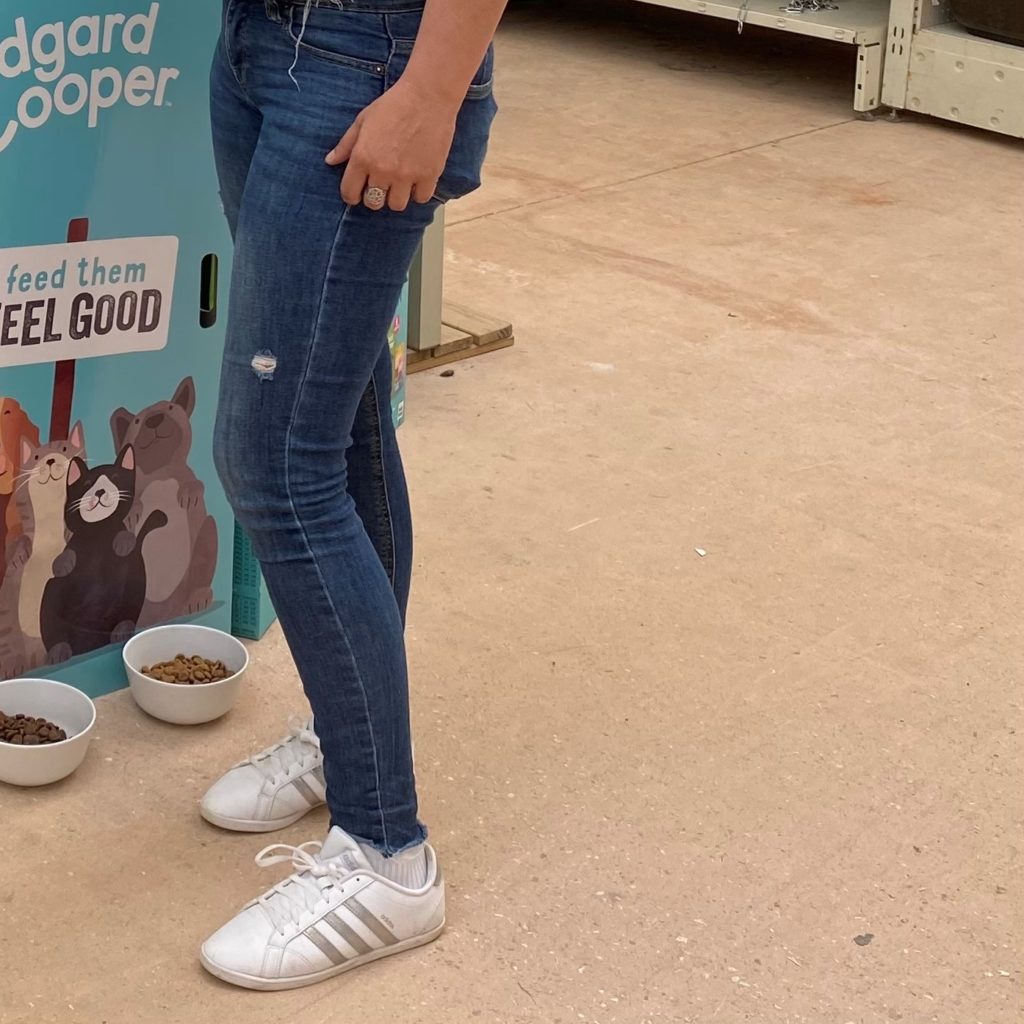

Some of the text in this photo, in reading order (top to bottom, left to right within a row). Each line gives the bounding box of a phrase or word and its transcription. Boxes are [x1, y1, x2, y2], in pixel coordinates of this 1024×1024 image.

[7, 257, 146, 294] feed them
[69, 288, 162, 340] GOOD
